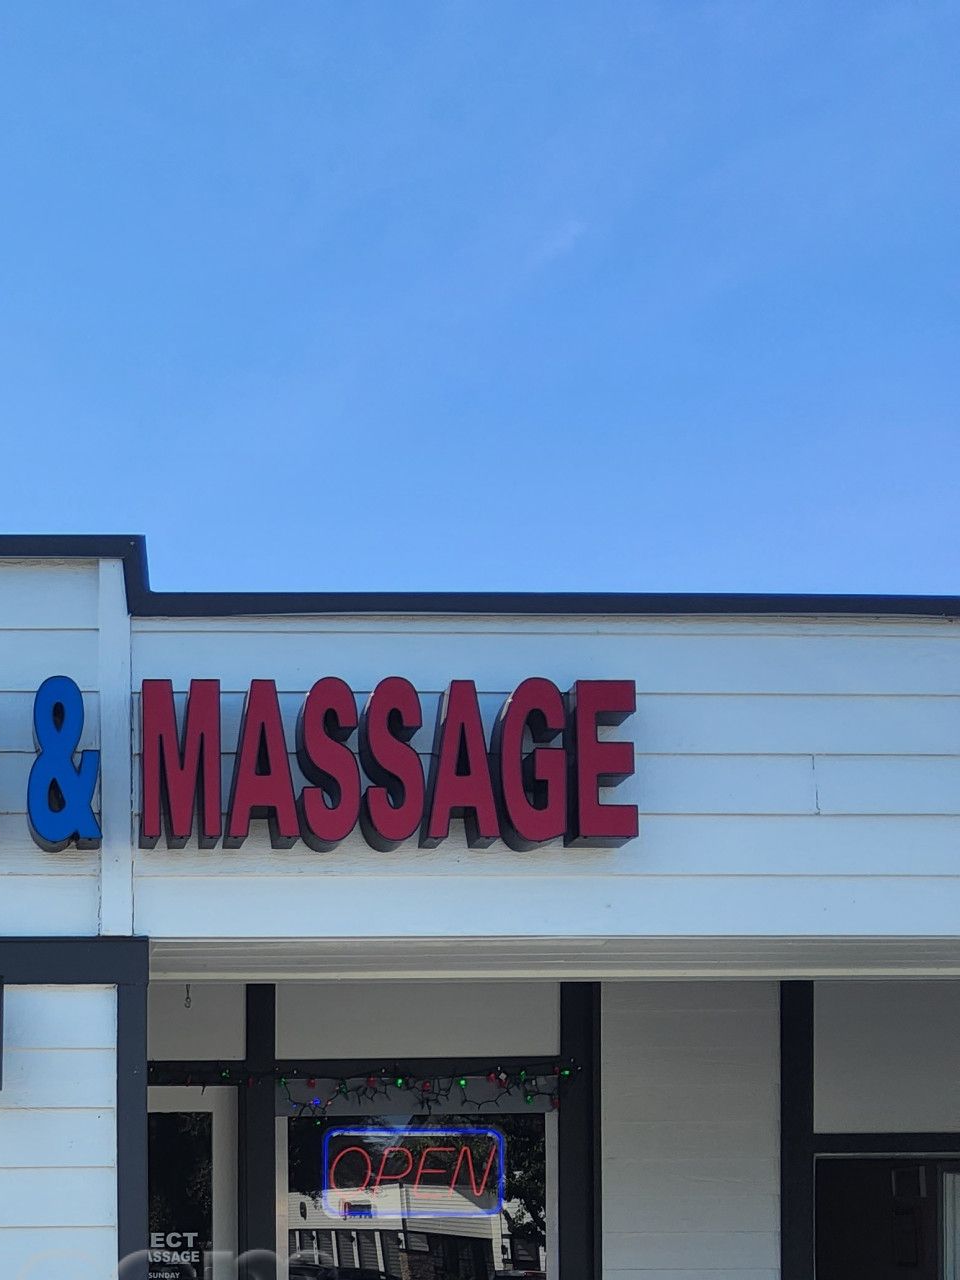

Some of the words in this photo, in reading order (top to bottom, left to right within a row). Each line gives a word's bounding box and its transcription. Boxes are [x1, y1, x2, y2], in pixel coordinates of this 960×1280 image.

[28, 675, 103, 849] &
[140, 676, 640, 851] MASSAGE
[328, 1144, 497, 1199] OPEN
[150, 1232, 198, 1248] ECT
[148, 1272, 181, 1280] SUNDAY
